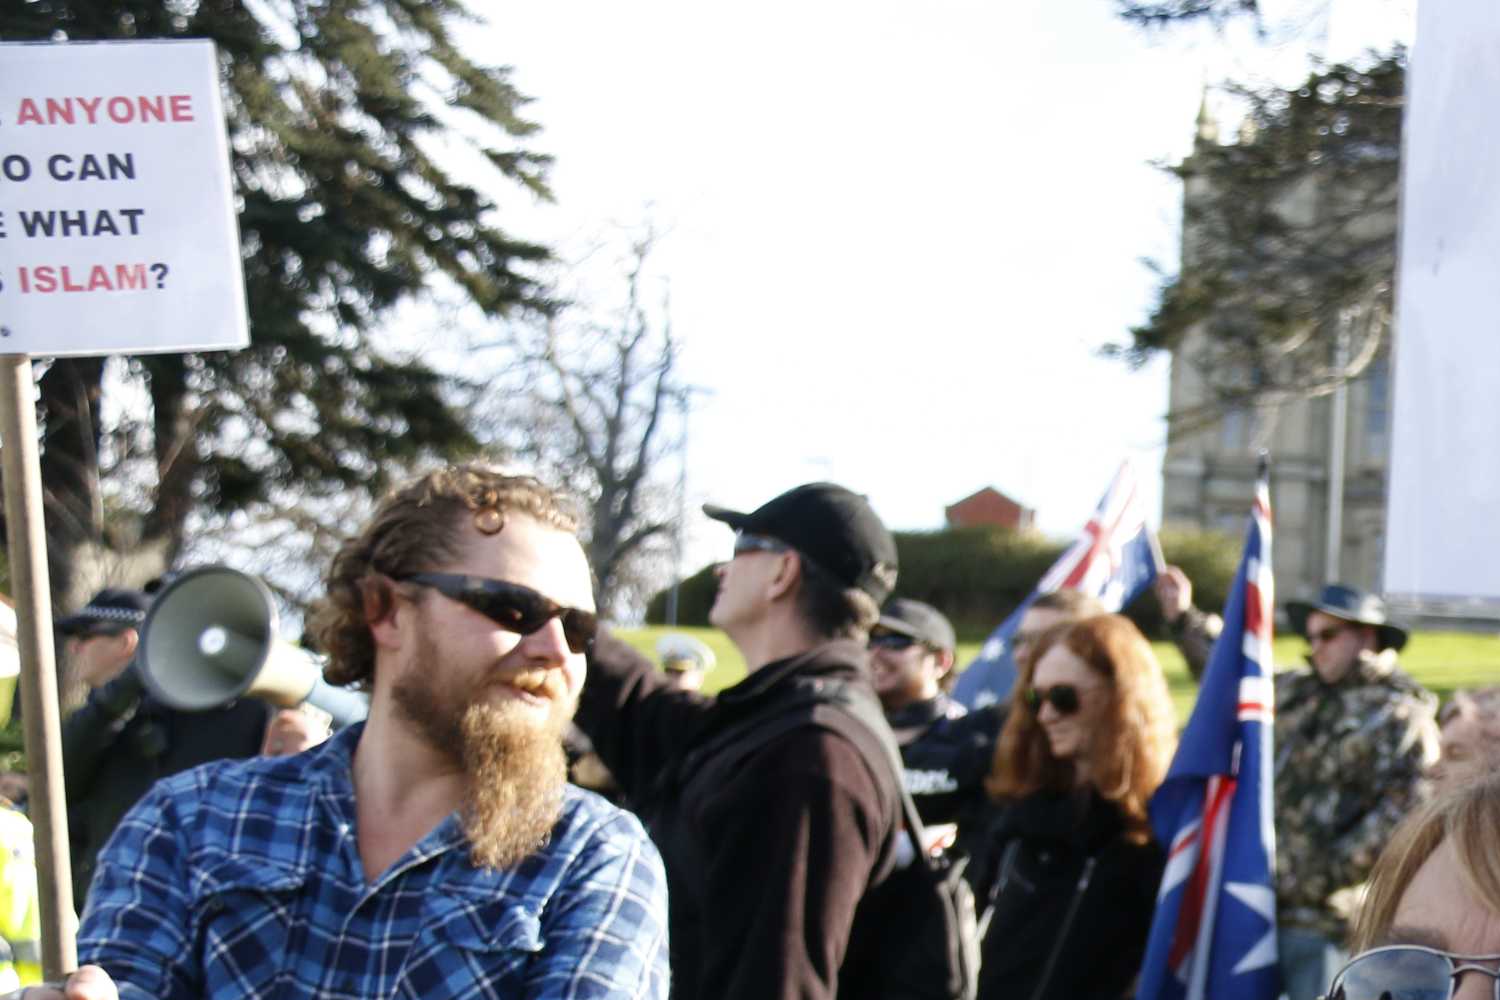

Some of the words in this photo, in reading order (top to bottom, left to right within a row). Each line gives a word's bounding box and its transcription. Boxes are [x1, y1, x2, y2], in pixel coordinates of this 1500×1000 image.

[16, 95, 195, 126] ANYONE
[0, 153, 32, 183] O
[47, 152, 137, 182] CAN
[17, 208, 145, 238] WHAT
[17, 262, 169, 294] ISLAM?
